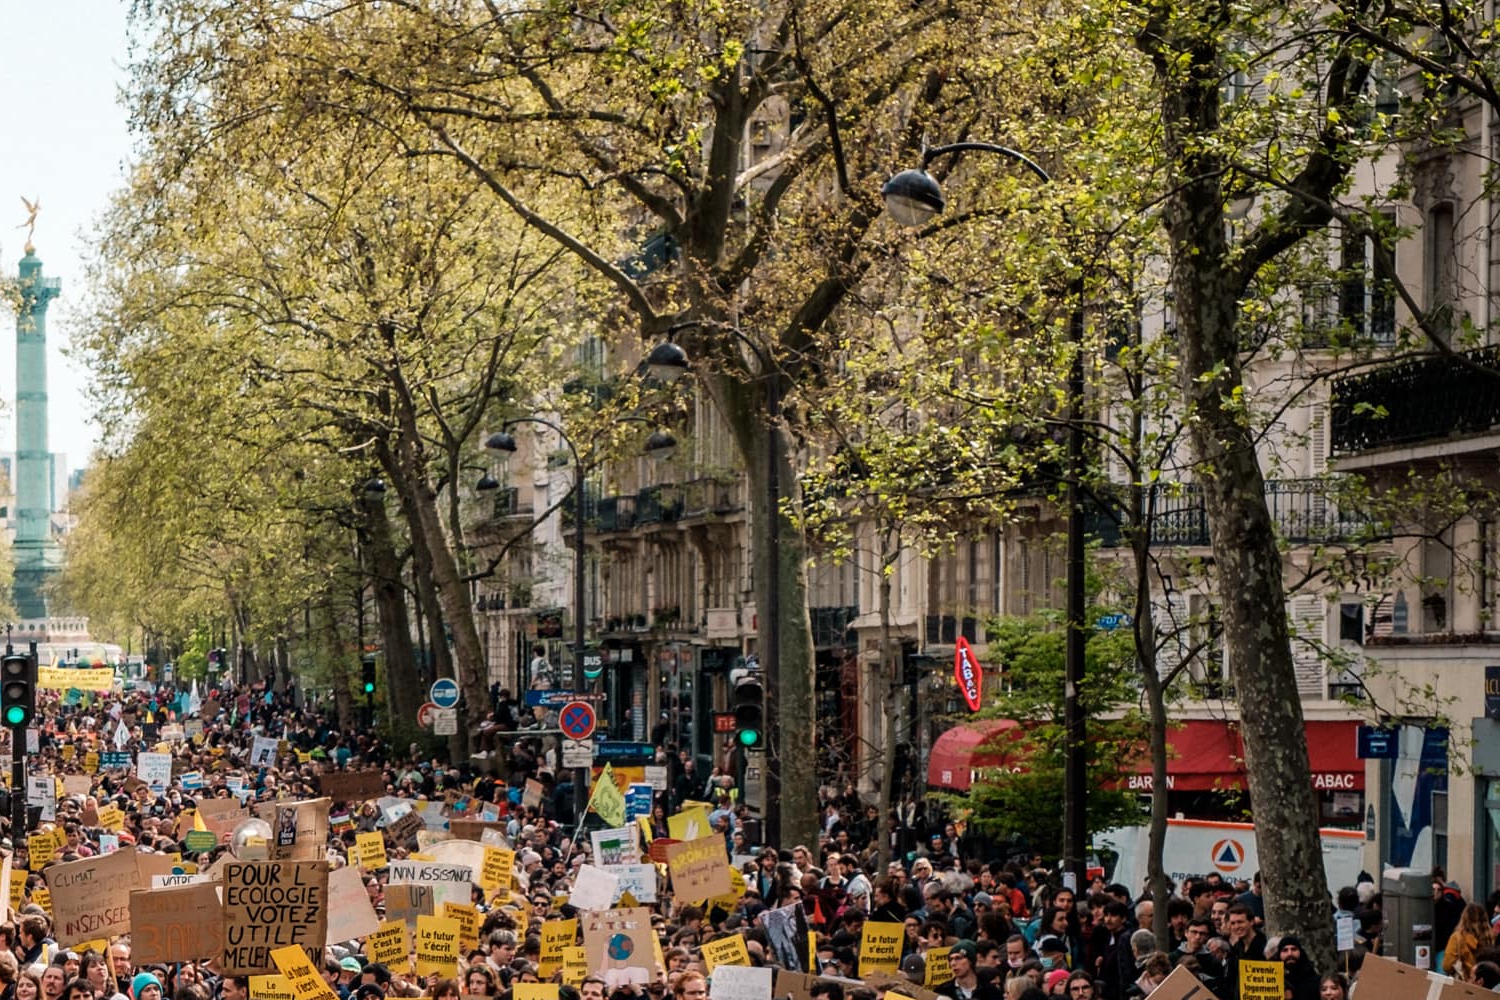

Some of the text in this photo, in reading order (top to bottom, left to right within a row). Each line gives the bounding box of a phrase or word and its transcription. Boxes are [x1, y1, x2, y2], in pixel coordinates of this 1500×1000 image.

[584, 656, 601, 666] BUS
[1311, 773, 1355, 789] TABAC
[228, 863, 281, 885] POUR
[392, 866, 473, 883] NON ASSISTANCE
[228, 886, 319, 905] ECOLOGIE
[246, 905, 321, 924] VOTEZ
[228, 926, 307, 945] UTILE
[420, 928, 456, 941] Le futur
[423, 940, 451, 953] s'écrit
[417, 953, 458, 964] ensemble
